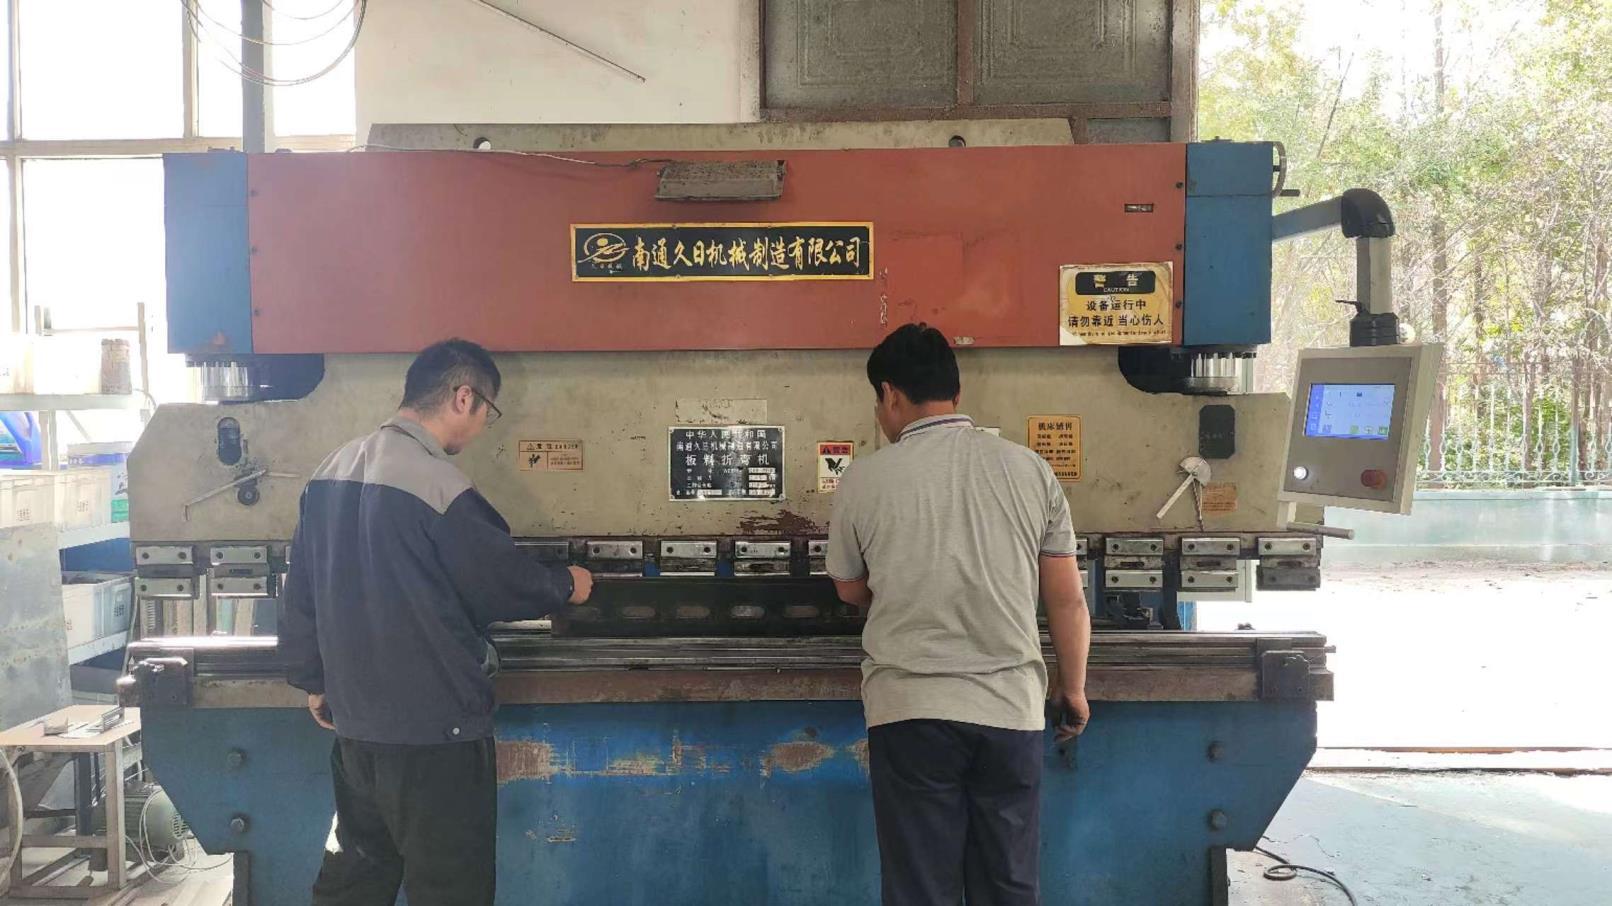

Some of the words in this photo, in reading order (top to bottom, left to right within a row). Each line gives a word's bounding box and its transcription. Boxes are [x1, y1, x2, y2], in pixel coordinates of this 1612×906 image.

[632, 236, 861, 271] 南通久日机械制造有限公司
[1086, 299, 1147, 312] 设备运行中
[1068, 315, 1114, 327] 请勿靠近
[1118, 314, 1164, 327] 当心伤人
[685, 453, 770, 466] 板料折弯机
